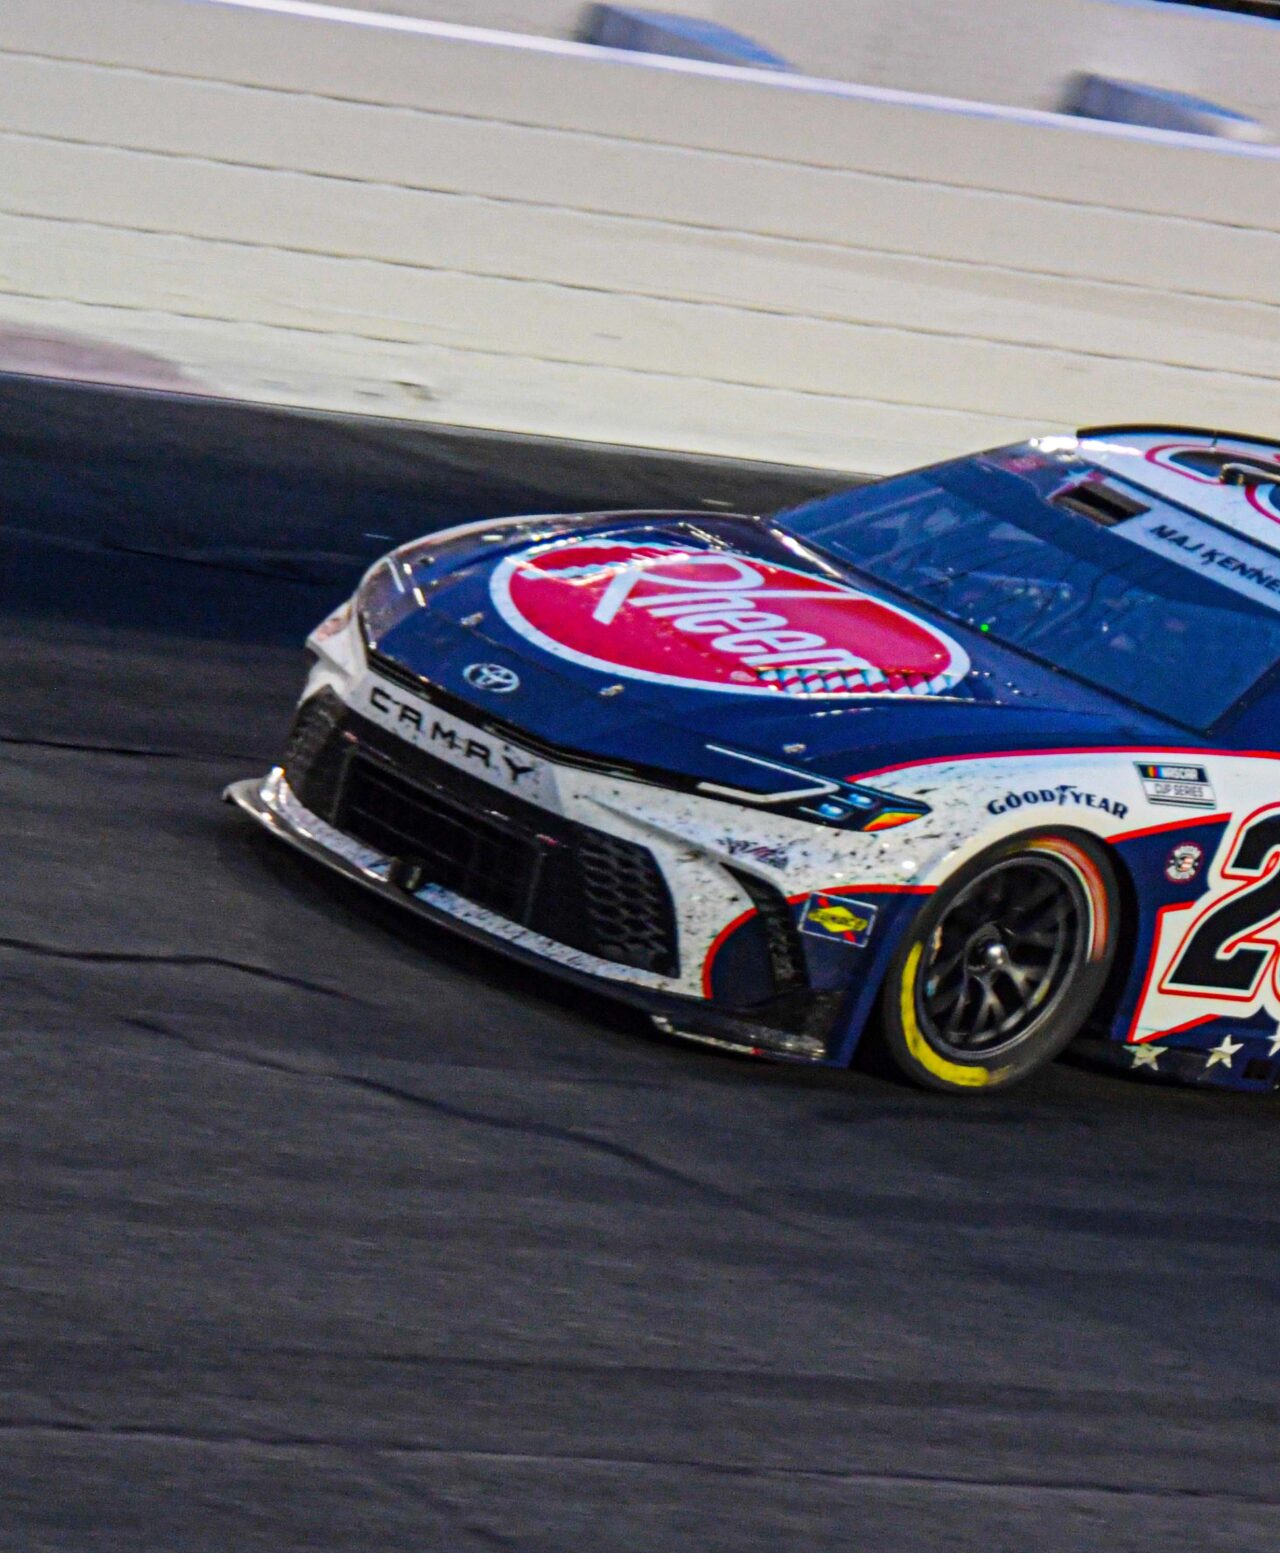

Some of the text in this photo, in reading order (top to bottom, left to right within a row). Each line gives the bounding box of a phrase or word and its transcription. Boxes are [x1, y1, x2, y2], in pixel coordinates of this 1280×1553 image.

[1150, 524, 1204, 553] MAJ
[518, 554, 882, 688] Rheem
[370, 686, 536, 783] CAMRY
[986, 785, 1129, 820] GOODYEAR
